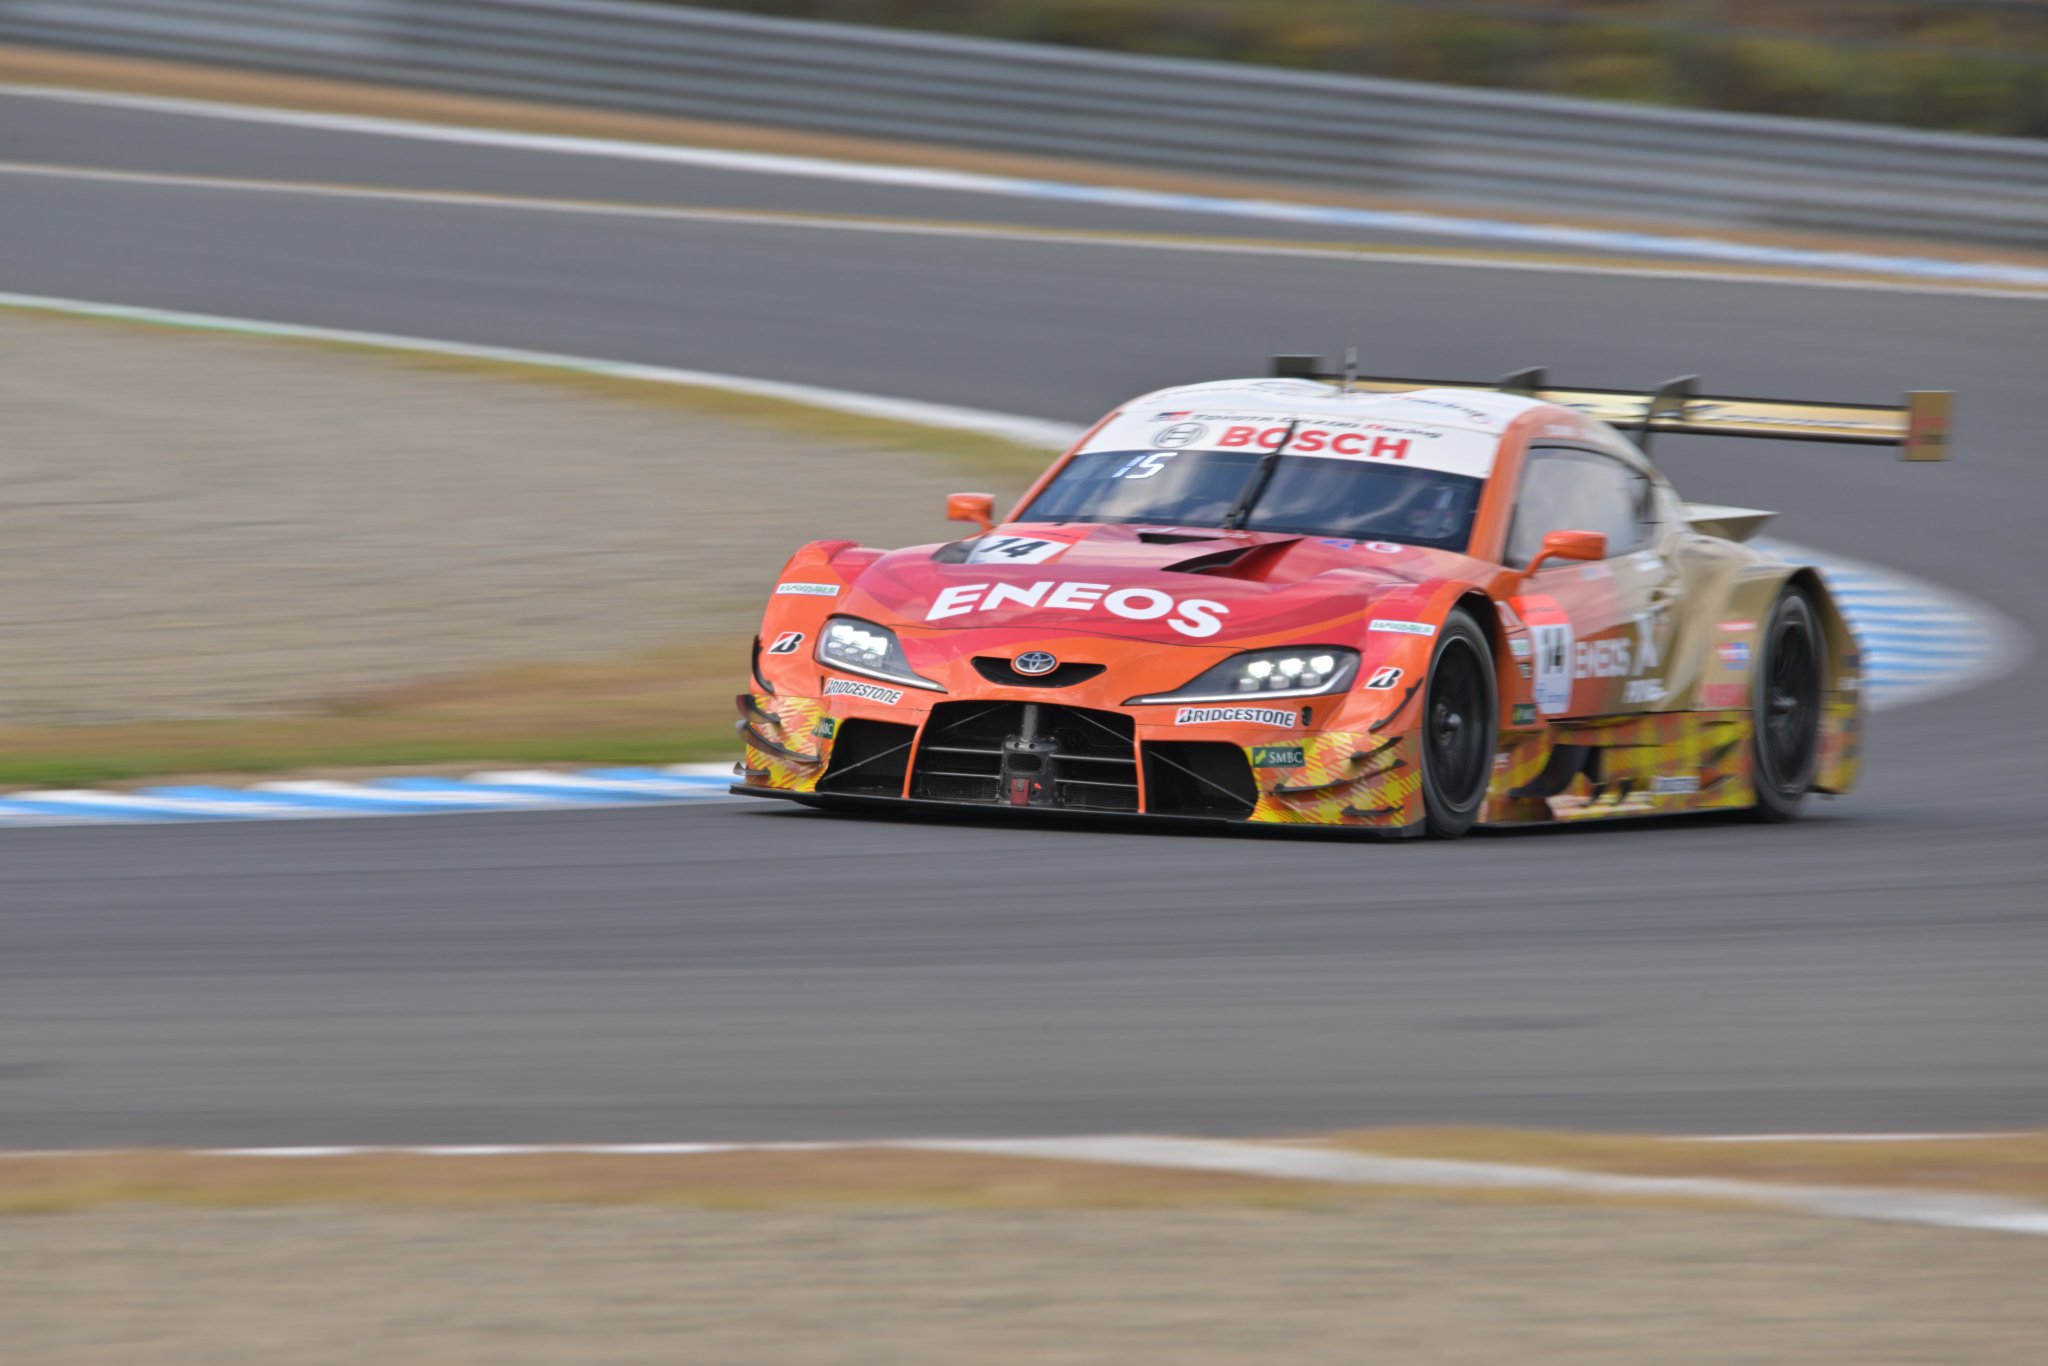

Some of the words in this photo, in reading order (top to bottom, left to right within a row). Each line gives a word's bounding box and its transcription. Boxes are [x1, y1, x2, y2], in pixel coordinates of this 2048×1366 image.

[1217, 425, 1412, 460] BOSCH
[979, 536, 1051, 558] 14
[925, 581, 1230, 638] ENEOS
[1541, 627, 1565, 675] 14
[825, 679, 902, 704] BRIDGESTONE
[1178, 708, 1296, 727] BRIDGESTONE
[1268, 750, 1303, 765] SMBC
